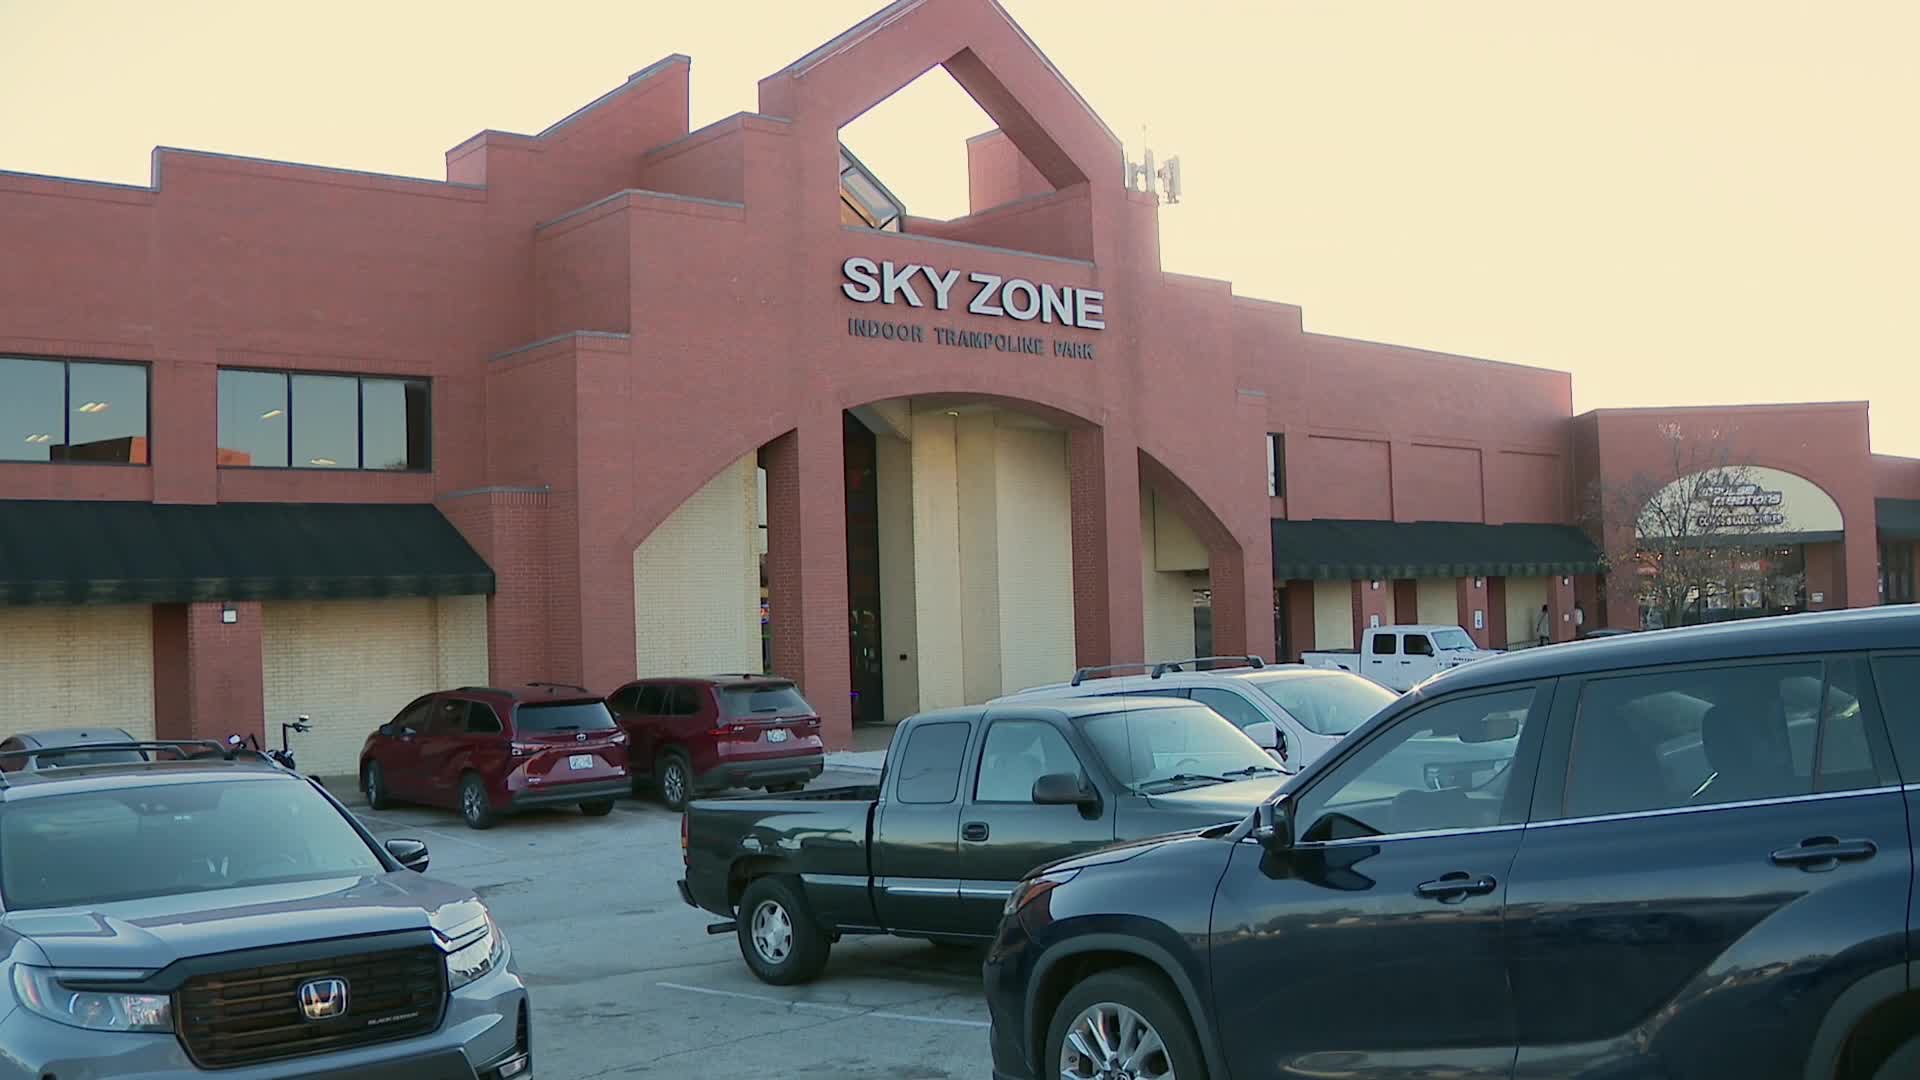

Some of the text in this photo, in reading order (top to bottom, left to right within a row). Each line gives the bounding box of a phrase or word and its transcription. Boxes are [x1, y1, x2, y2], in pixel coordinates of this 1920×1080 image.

[842, 257, 1106, 330] SKY ZONE
[848, 317, 1095, 361] INDOOR TRAMPOLINE PARK
